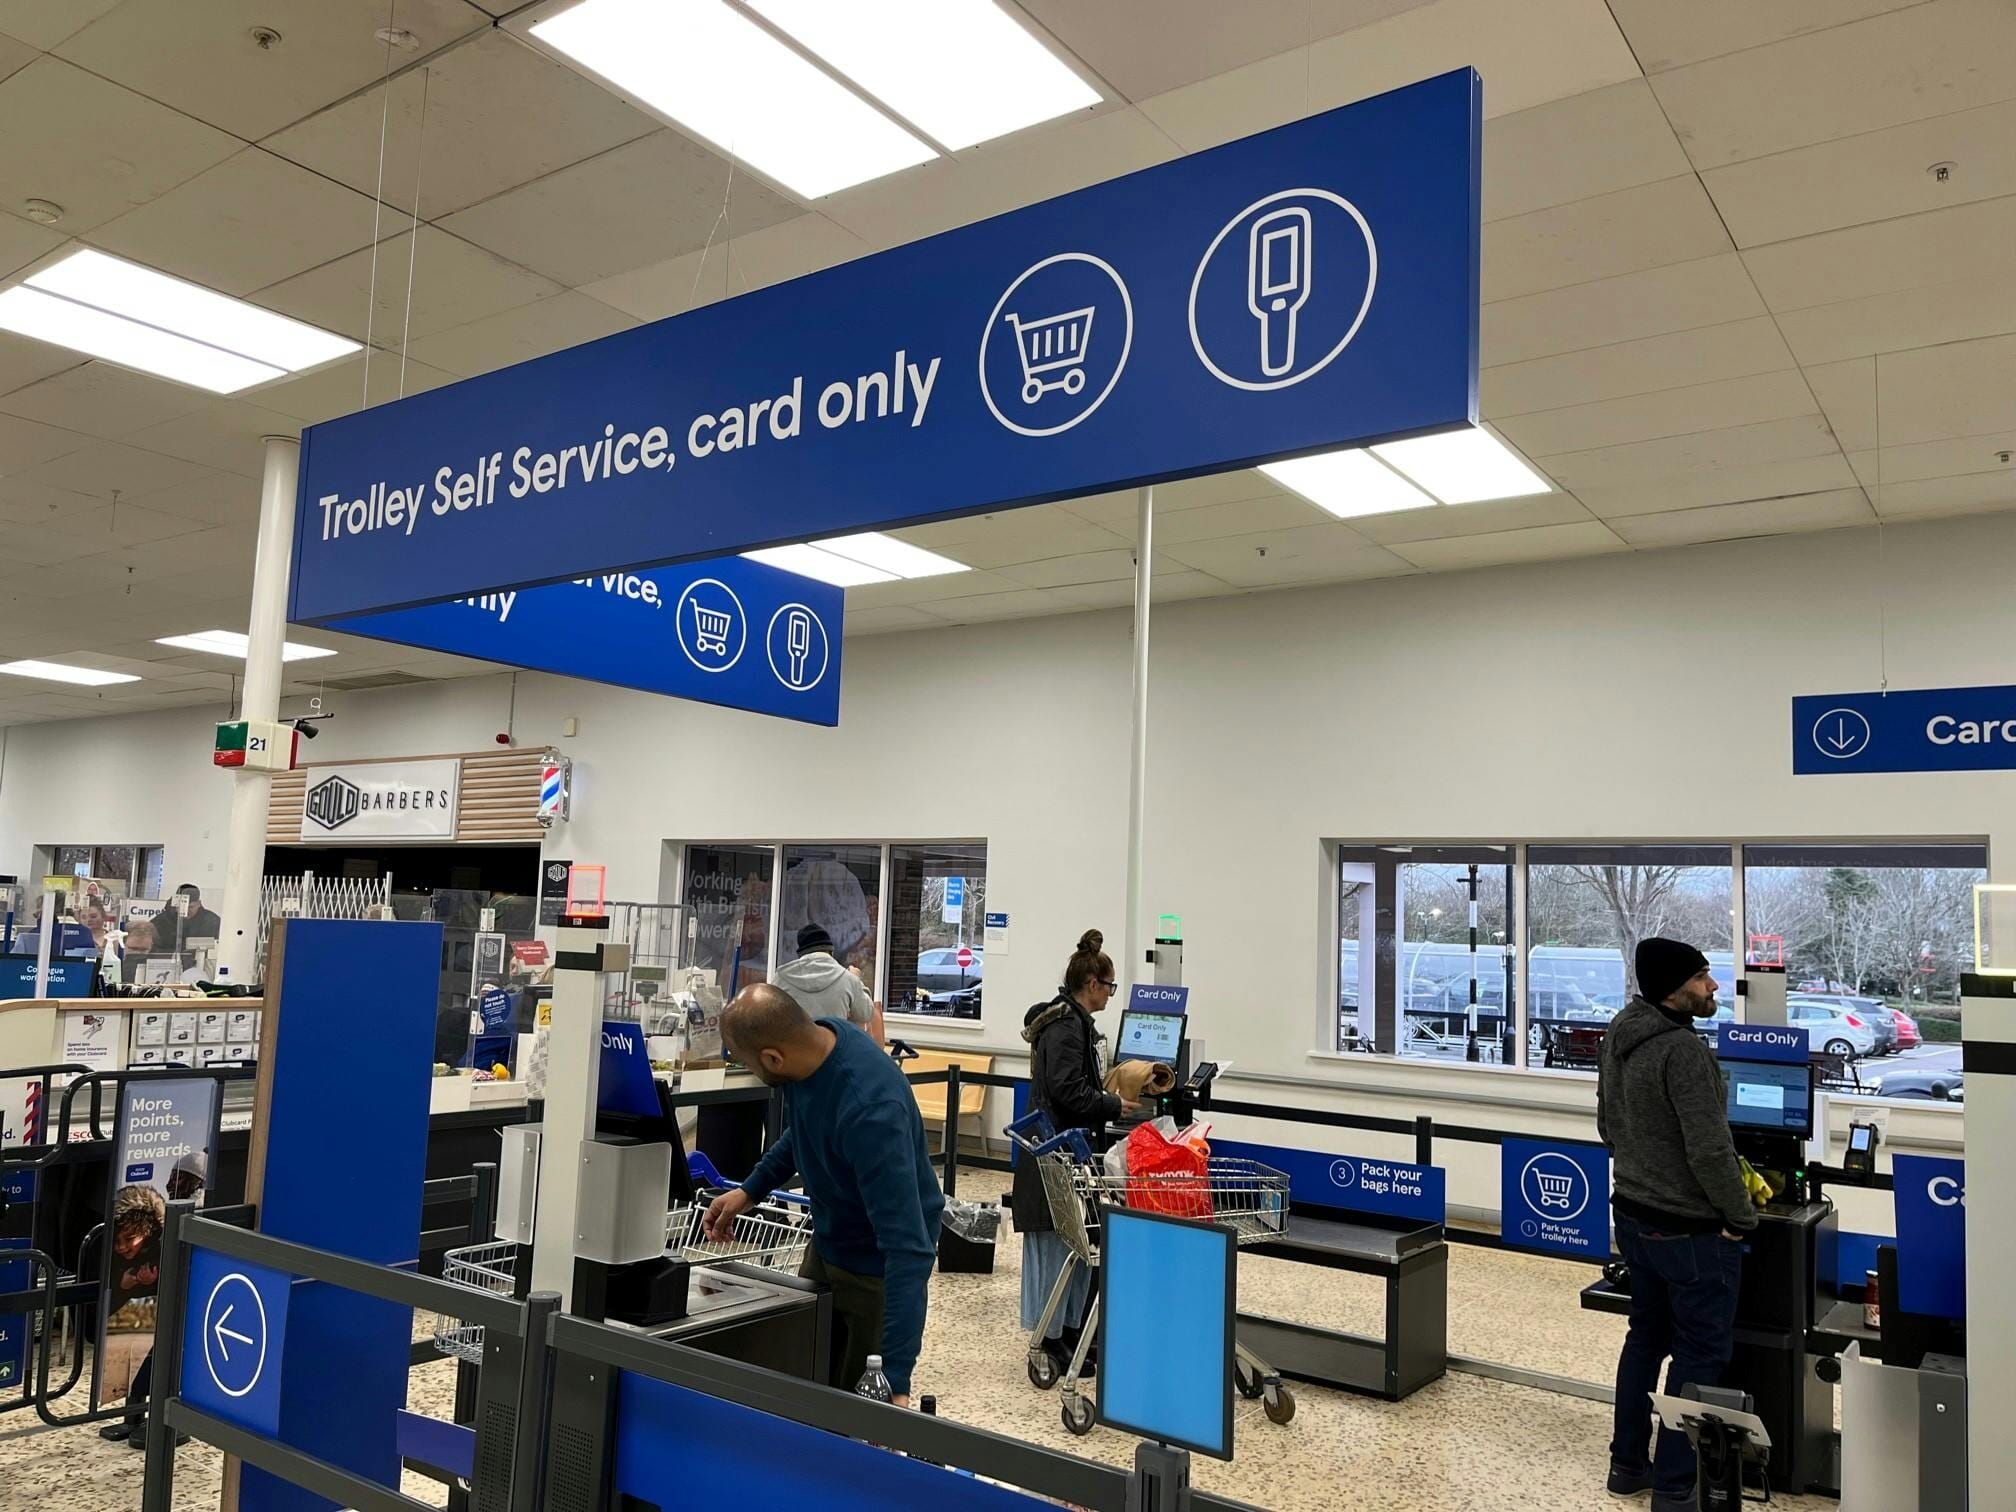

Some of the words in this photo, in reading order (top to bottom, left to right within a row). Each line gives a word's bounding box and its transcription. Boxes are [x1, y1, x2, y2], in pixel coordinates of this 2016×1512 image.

[319, 481, 425, 541] Trolley
[431, 452, 502, 516] Self
[508, 423, 676, 499] Service,
[687, 376, 803, 458] card
[817, 350, 941, 428] only
[250, 737, 266, 751] 21
[308, 780, 357, 826] GOULD
[361, 790, 449, 811] BARBERS
[688, 894, 713, 914] ith
[1137, 988, 1159, 999] Card
[1160, 990, 1181, 1002] Only
[601, 1031, 633, 1055] Only
[1728, 1029, 1762, 1043] Card
[1765, 1032, 1799, 1047] Only
[132, 1098, 173, 1112] More
[129, 1113, 185, 1132] points,
[128, 1130, 171, 1145] more
[126, 1142, 192, 1161] rewards
[1338, 1167, 1346, 1180] 3
[1361, 1162, 1391, 1178] Pack
[1393, 1169, 1423, 1182] your
[1361, 1177, 1389, 1194] bags
[1392, 1181, 1422, 1197] here
[1541, 1222, 1559, 1232] Park
[1561, 1226, 1580, 1235] your
[1541, 1233, 1567, 1244] trolley
[1568, 1236, 1589, 1246] here
